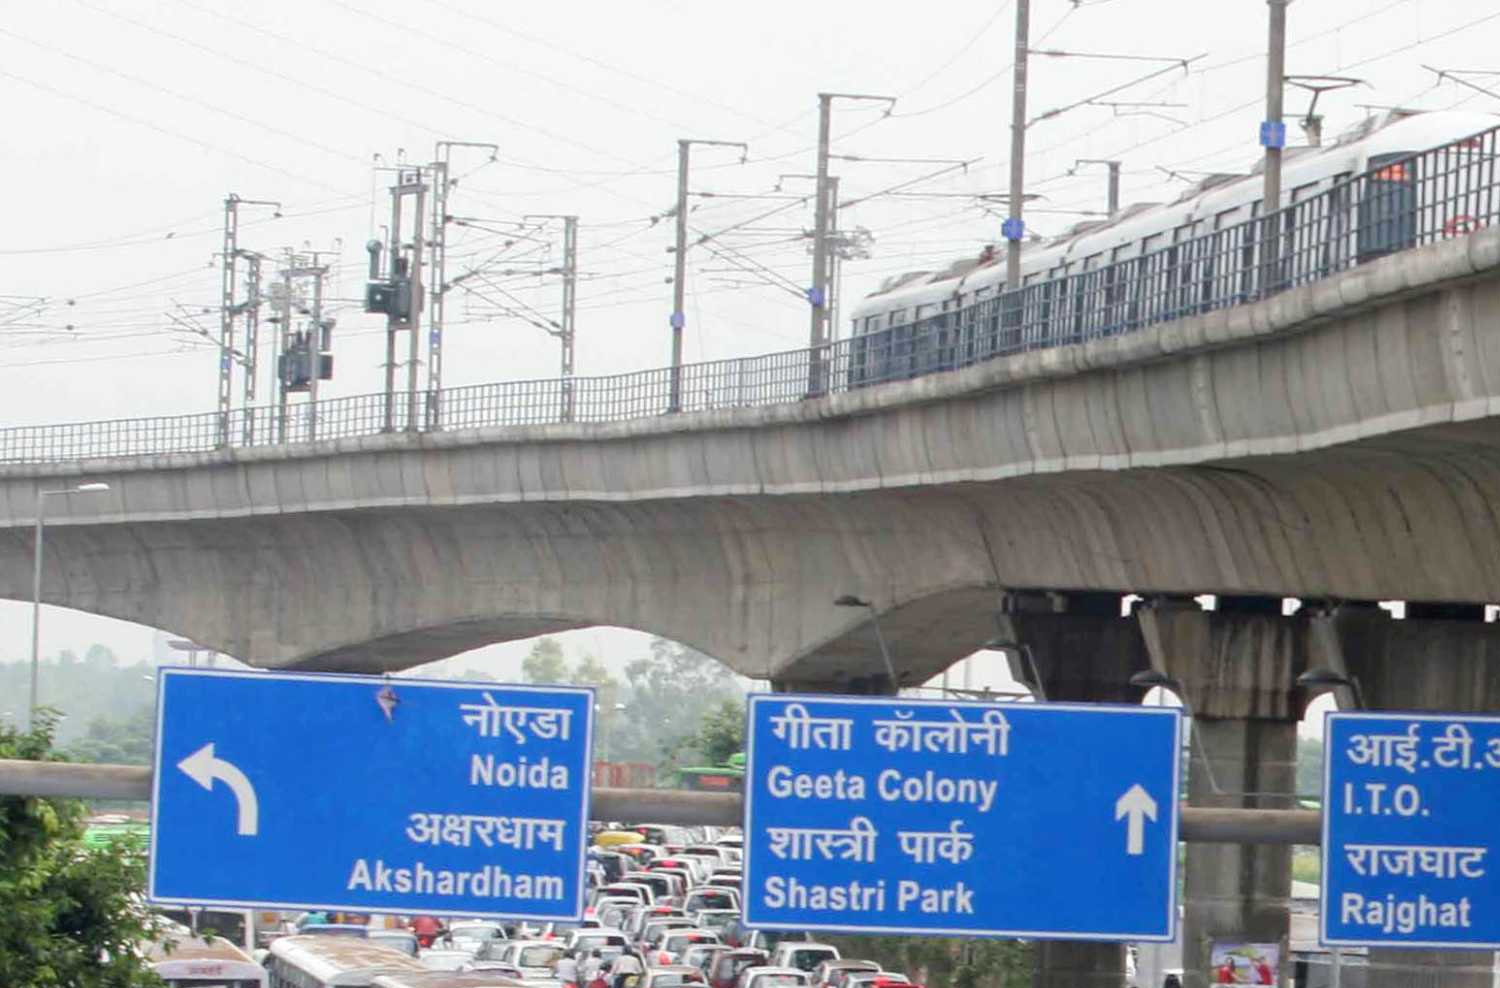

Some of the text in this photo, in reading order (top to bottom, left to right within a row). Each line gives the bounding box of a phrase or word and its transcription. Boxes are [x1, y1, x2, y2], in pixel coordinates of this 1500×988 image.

[460, 693, 572, 744] नोएडा
[770, 704, 1010, 755] गीता कॉलोनी
[471, 755, 568, 790] Noida
[767, 766, 997, 812] Geeta Colony
[1344, 783, 1429, 816] I.T.O.
[406, 813, 565, 851] अक्षरधाम
[767, 817, 974, 864] शास्त्री पार्क
[347, 859, 564, 900] Akshardham
[1344, 844, 1487, 878] राजघाट
[764, 877, 974, 914] Shastri Park
[1341, 893, 1471, 932] Rajghat
